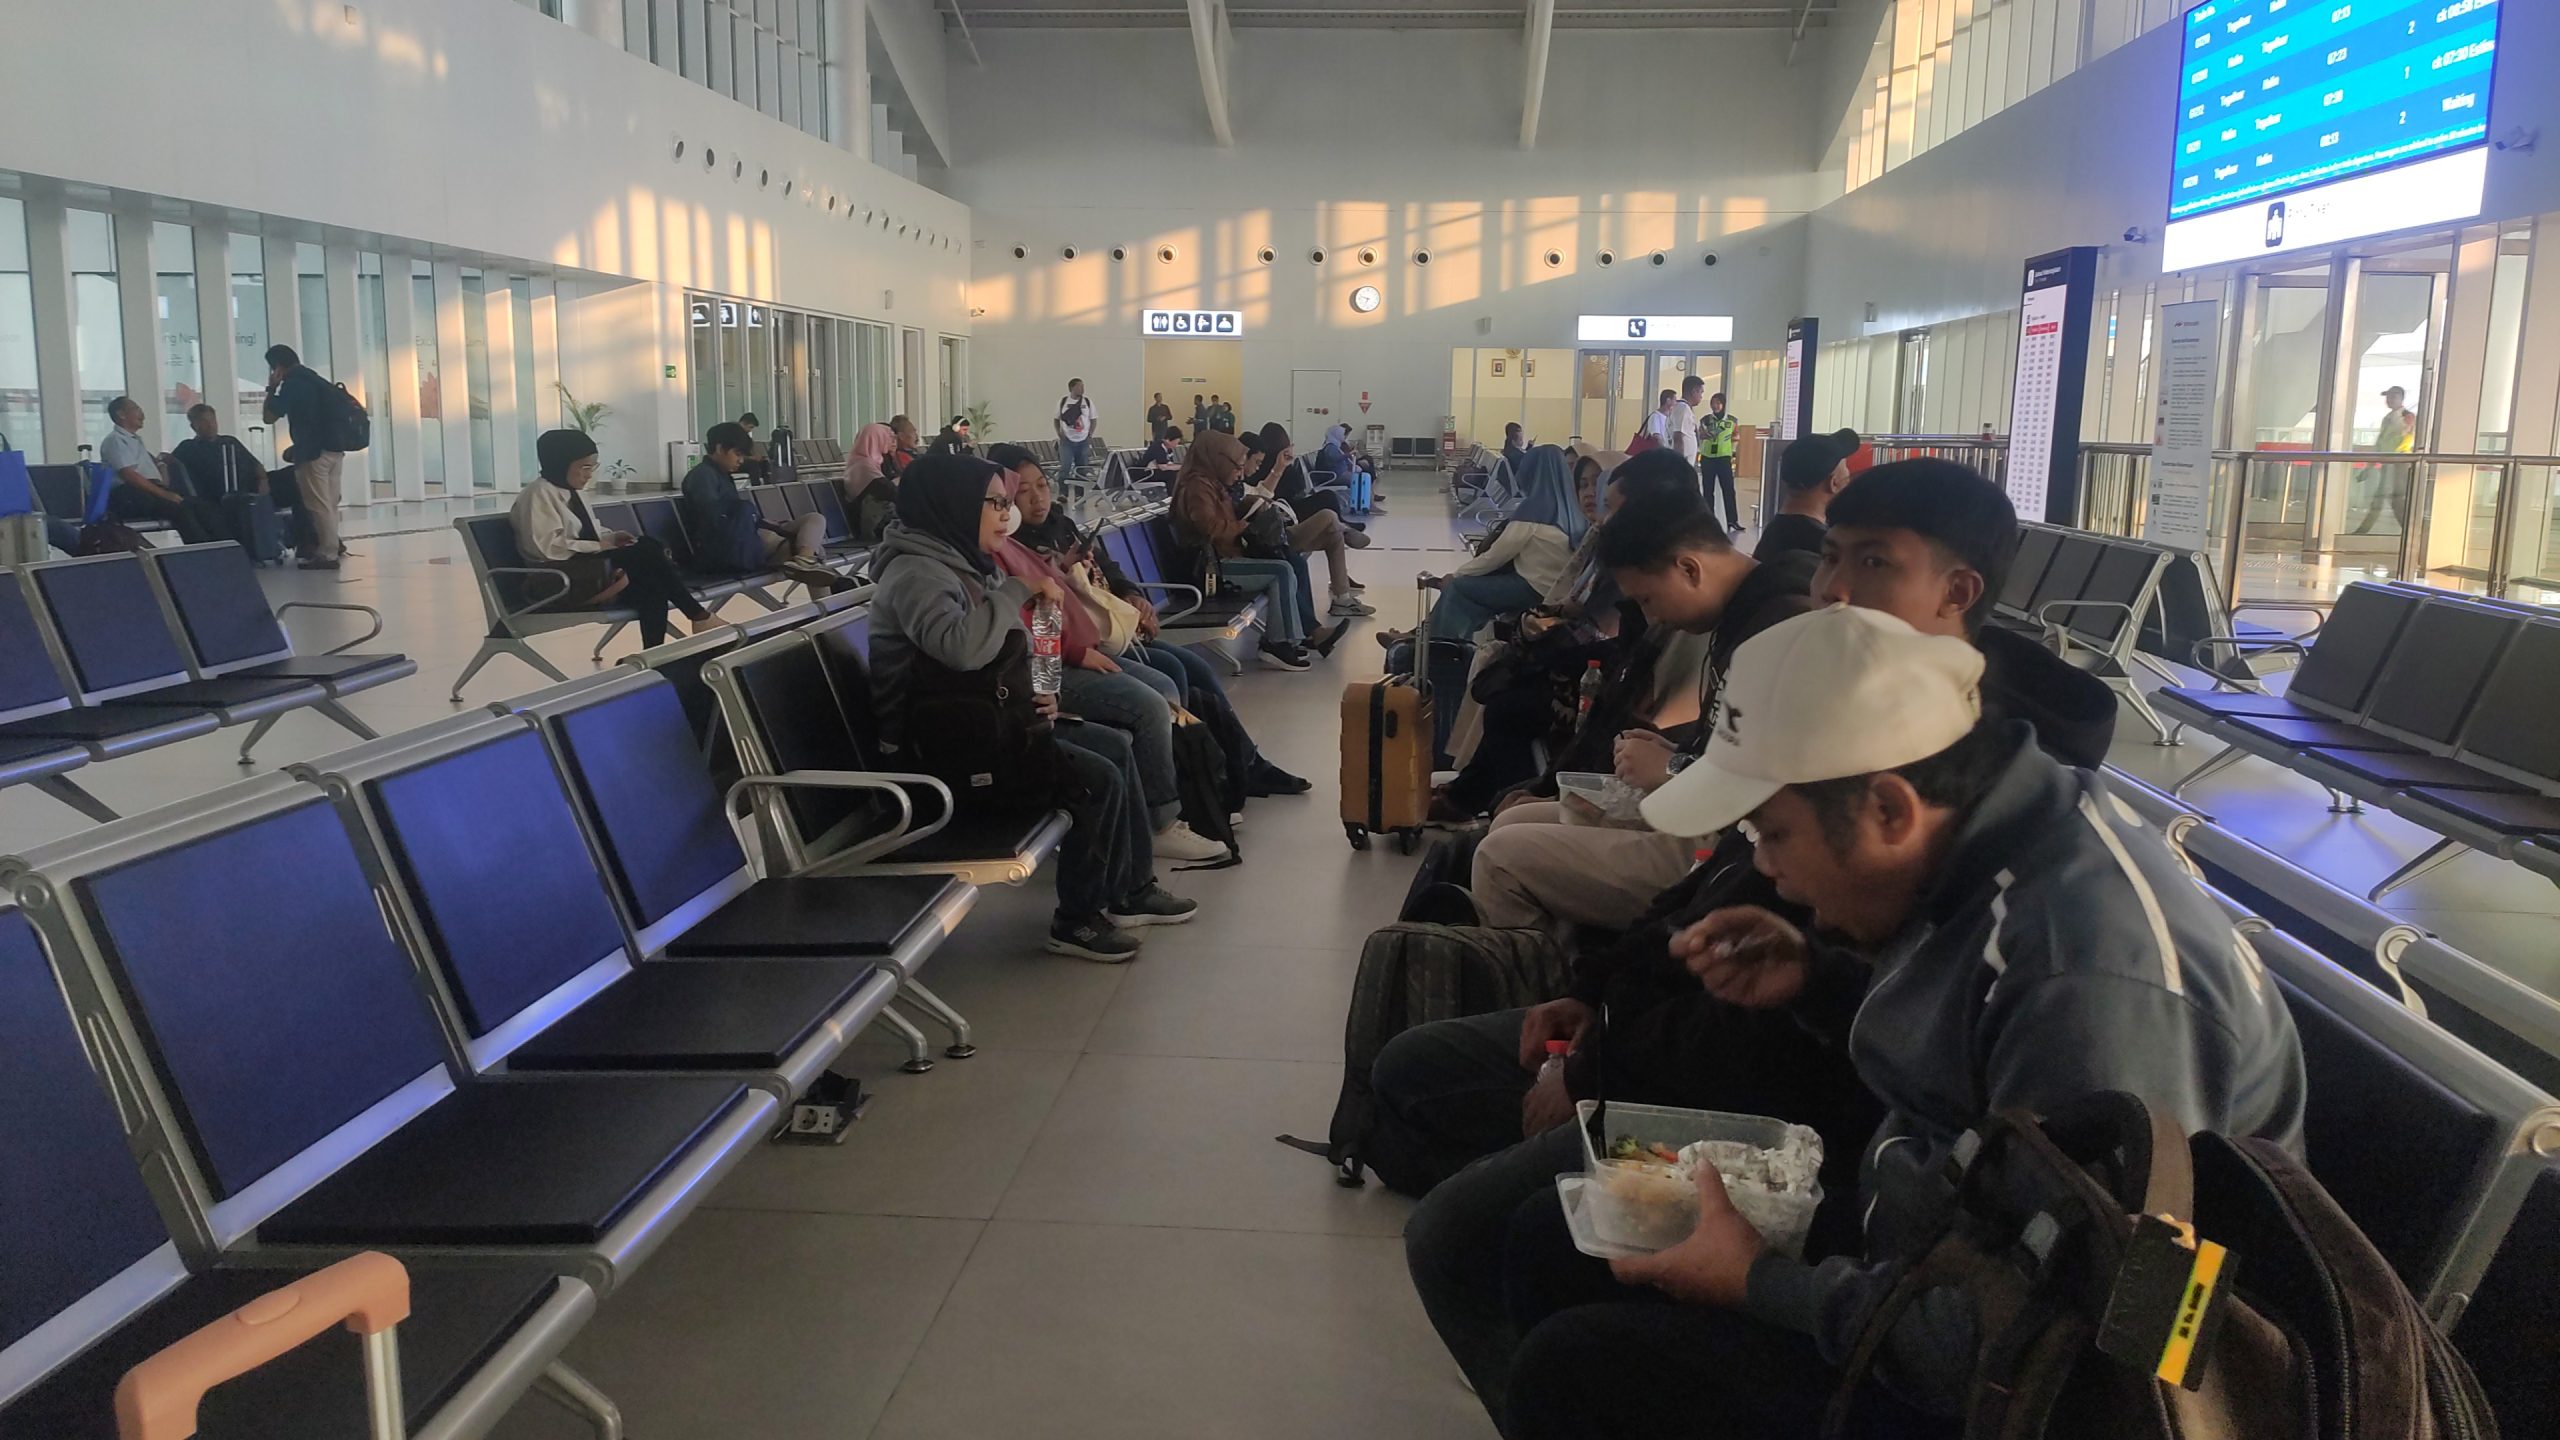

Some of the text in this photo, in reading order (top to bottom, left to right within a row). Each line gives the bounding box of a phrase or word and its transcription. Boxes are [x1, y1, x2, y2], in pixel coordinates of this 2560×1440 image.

[2408, 20, 2416, 34] 2
[2404, 66, 2410, 79] 1
[2399, 111, 2407, 125] 2
